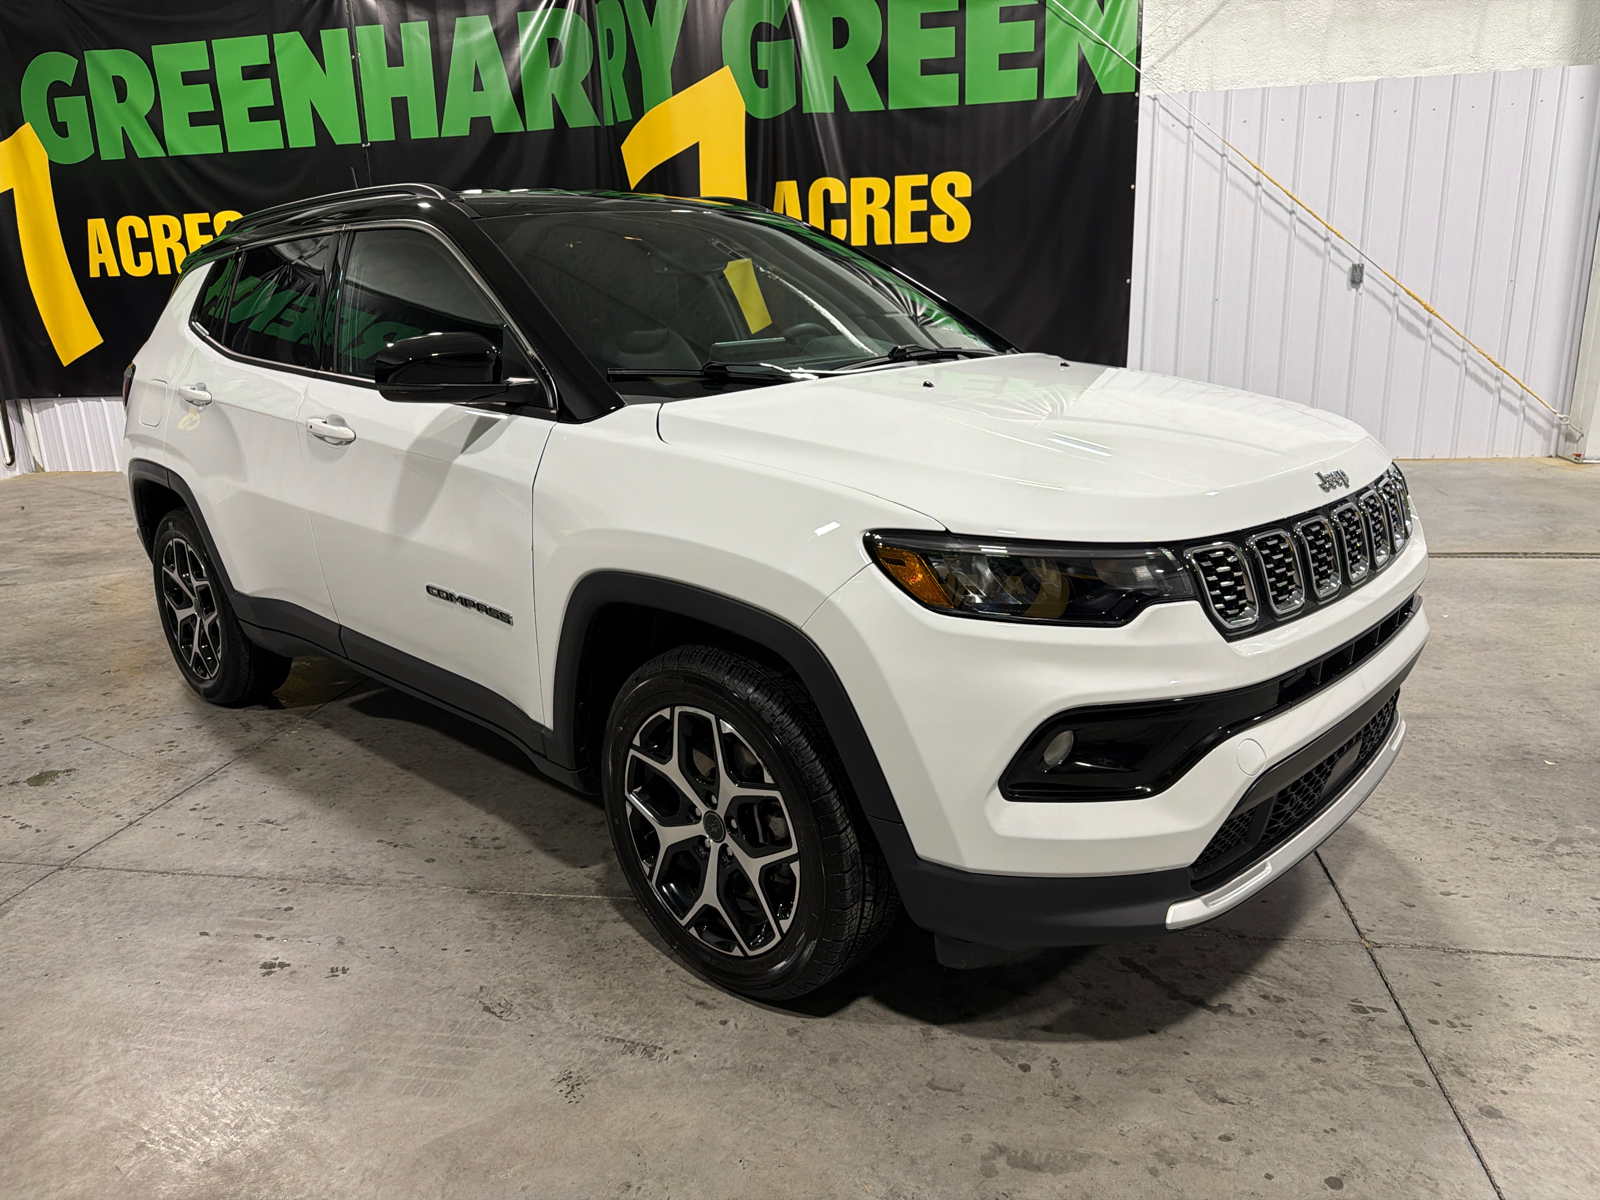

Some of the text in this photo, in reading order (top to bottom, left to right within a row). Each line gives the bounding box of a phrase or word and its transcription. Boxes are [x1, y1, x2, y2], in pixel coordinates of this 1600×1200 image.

[21, 31, 362, 165] GREEN
[356, 0, 1138, 142] HARRY GREEN
[773, 170, 972, 247] ACRES
[1314, 468, 1350, 493] Jeep
[425, 583, 514, 626] COMPASS
